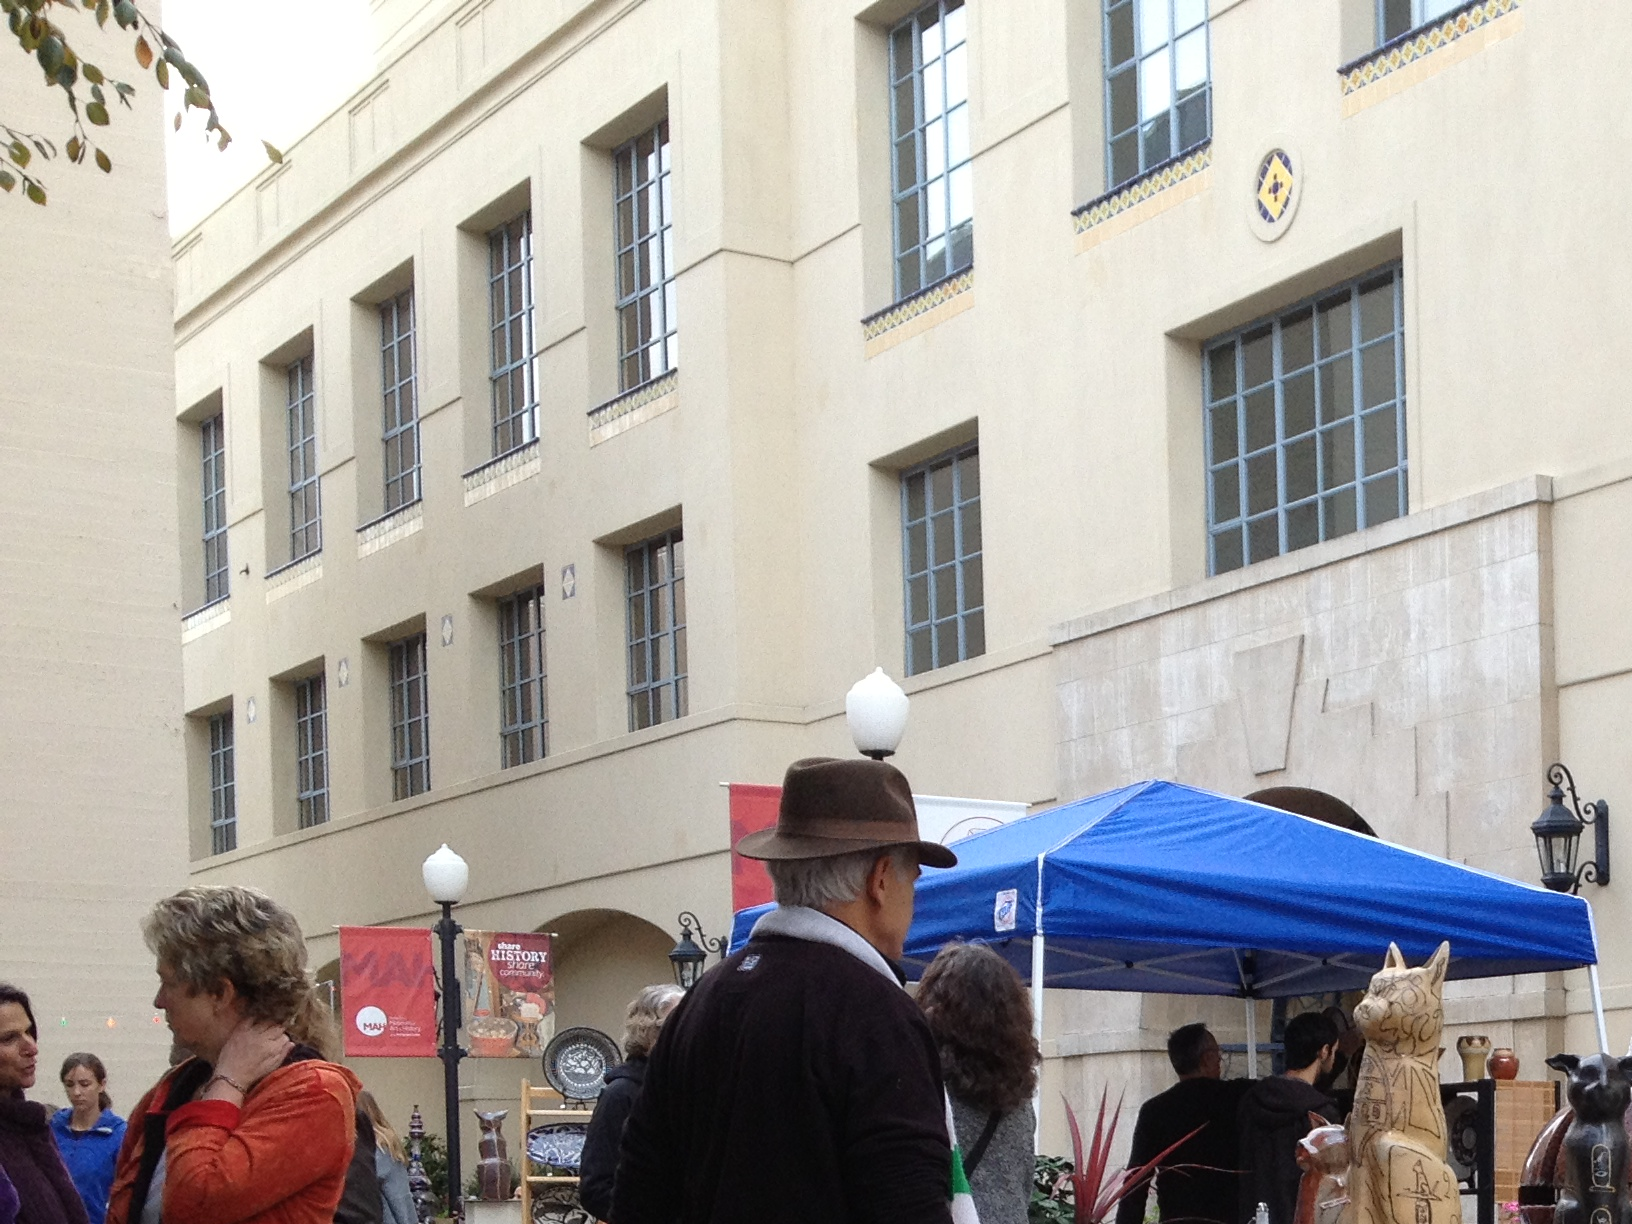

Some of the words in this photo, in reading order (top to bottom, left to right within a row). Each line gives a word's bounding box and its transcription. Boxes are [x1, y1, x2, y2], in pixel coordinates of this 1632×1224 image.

[497, 941, 521, 950] share
[490, 949, 548, 963] HISTORY
[507, 960, 535, 970] share
